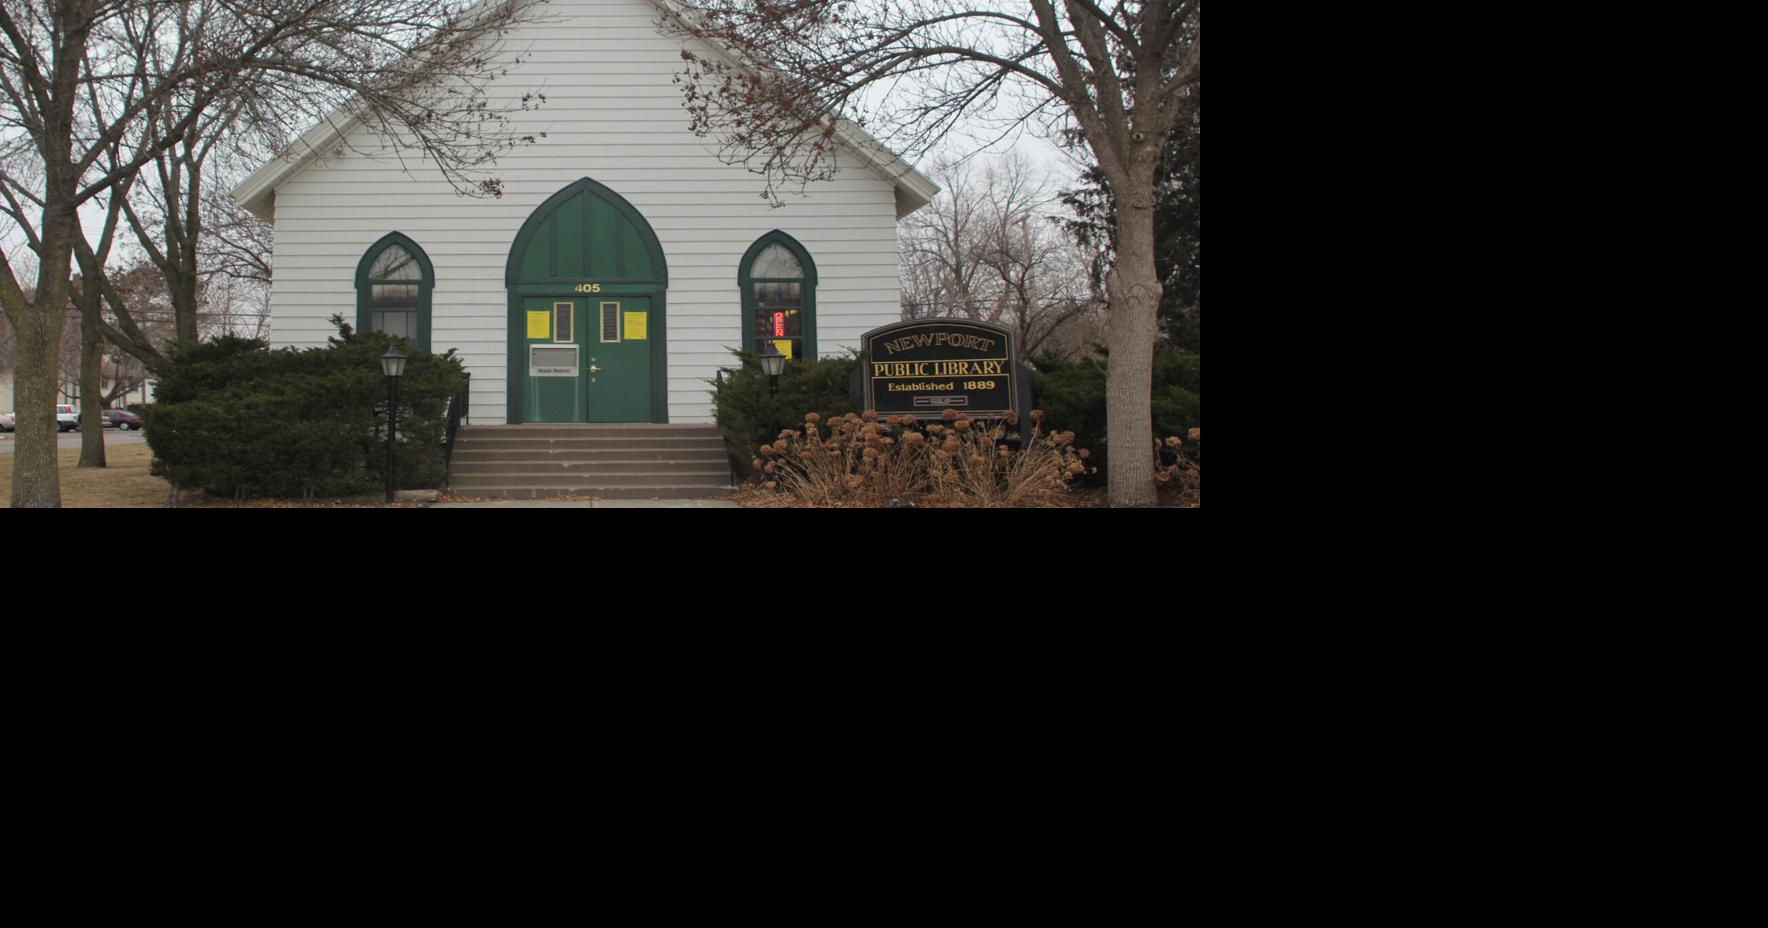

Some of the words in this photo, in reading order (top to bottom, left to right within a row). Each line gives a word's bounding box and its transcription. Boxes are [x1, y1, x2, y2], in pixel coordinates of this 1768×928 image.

[575, 284, 600, 292] 405
[775, 312, 784, 336] OPEN
[884, 333, 995, 354] NEWPORT
[874, 362, 929, 376] PUBLIC
[936, 361, 1004, 375] LIBRARY
[888, 382, 954, 391] Established
[964, 381, 995, 390] 1889
